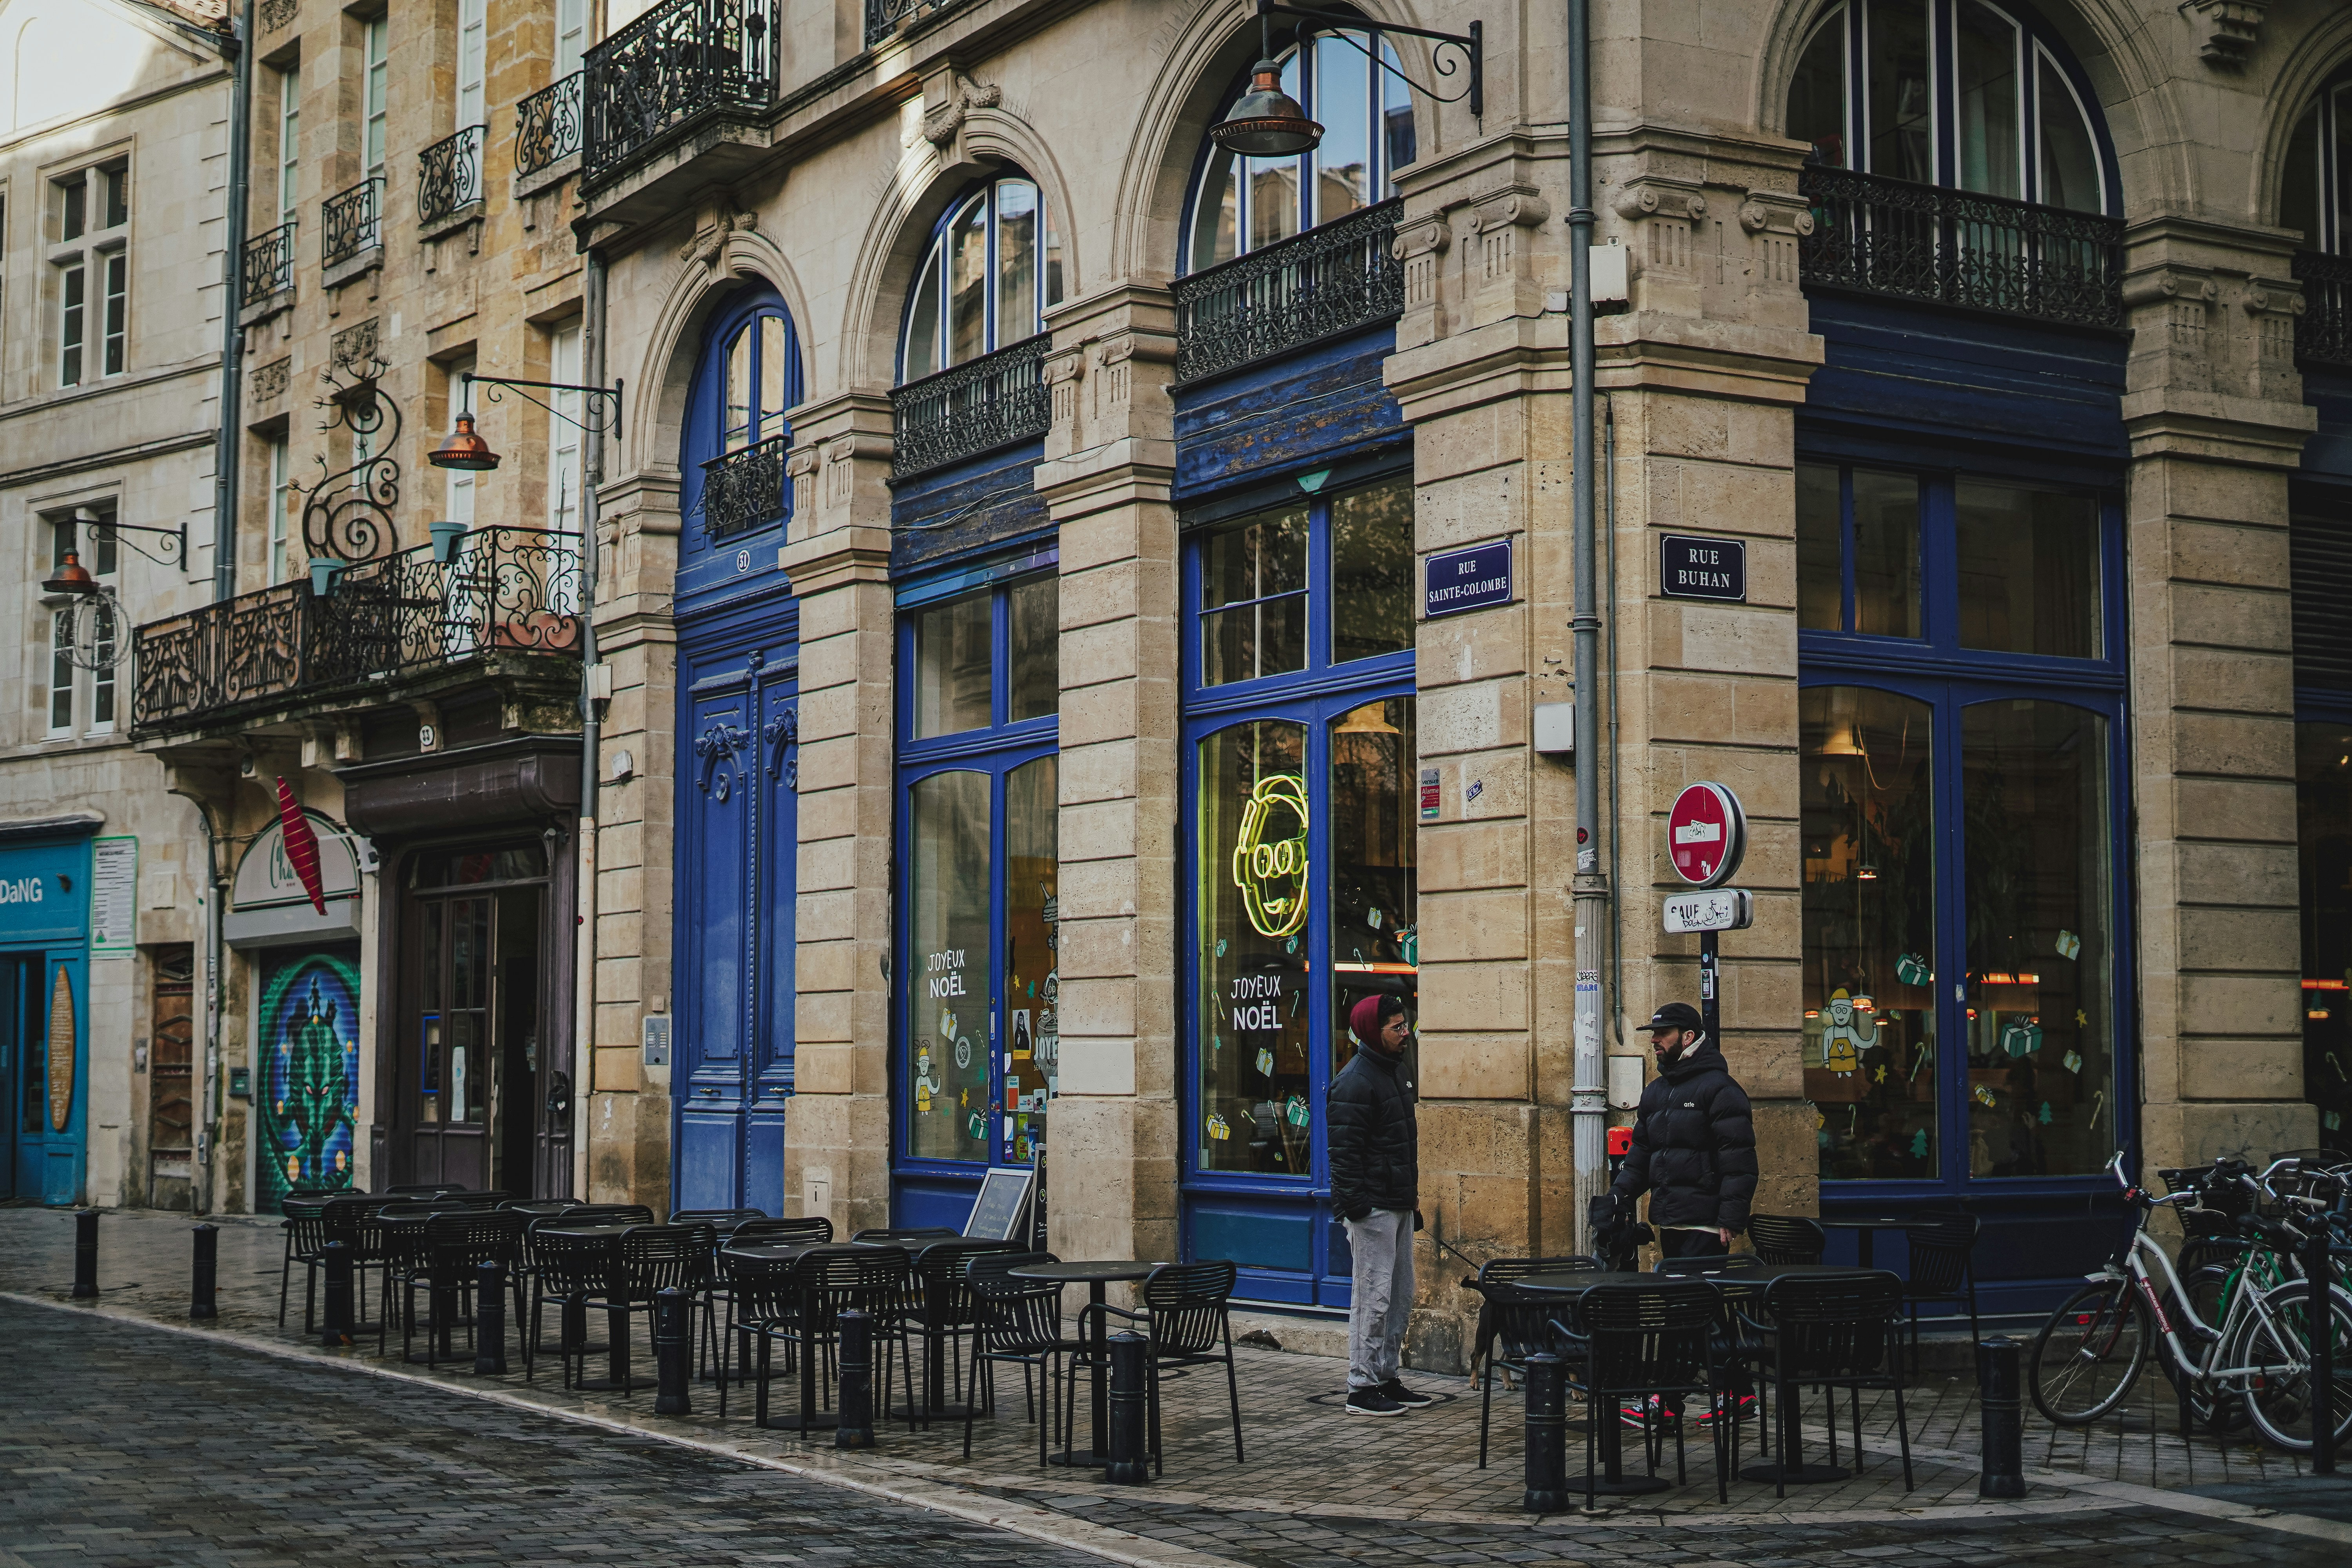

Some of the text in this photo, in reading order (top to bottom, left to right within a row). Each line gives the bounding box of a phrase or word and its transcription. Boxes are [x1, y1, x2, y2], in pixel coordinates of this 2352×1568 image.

[739, 554, 747, 568] 31
[1689, 548, 1719, 564] RUE
[1458, 560, 1476, 575] RUE
[1429, 577, 1506, 603] SAINTE-COLOMBE
[1678, 570, 1730, 588] BUHAN
[927, 949, 965, 971] JOYEUX
[930, 971, 966, 998] NOËL
[1230, 975, 1281, 999] JOYEUX
[1234, 1000, 1282, 1030] NOËL
